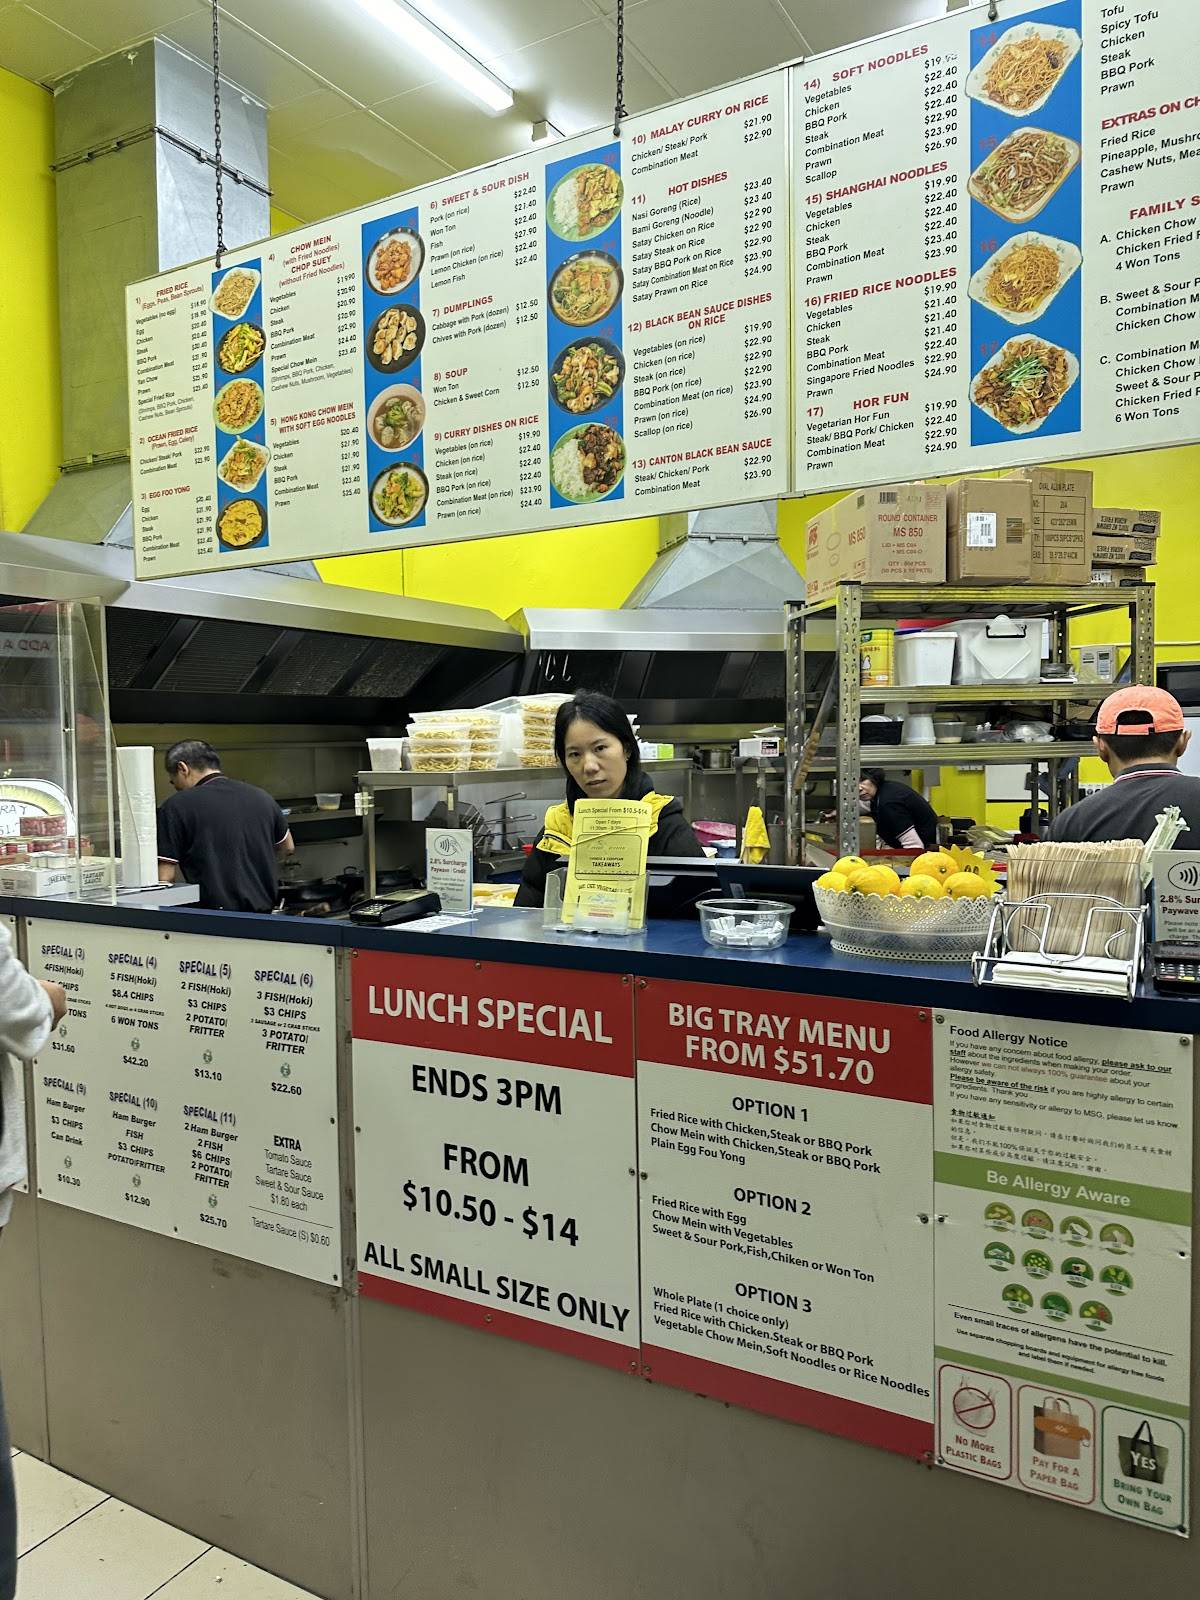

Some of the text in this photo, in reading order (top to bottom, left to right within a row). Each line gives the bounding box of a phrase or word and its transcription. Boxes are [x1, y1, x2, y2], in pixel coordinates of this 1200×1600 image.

[1100, 5, 1124, 17] Tofu
[1100, 10, 1158, 33] Spicy Tofu
[1100, 30, 1144, 48] Chicken
[1100, 48, 1131, 64] Steak
[803, 44, 928, 90] 14) SOFT NOODLES
[924, 65, 957, 83] $22.40
[1100, 57, 1154, 79] BBQ Pork
[1100, 80, 1134, 94] Prawn
[631, 94, 768, 144] 10) MALAY CURRY ON RICE
[743, 113, 771, 128] $21.90
[1101, 100, 1180, 130] EXTRAS ON
[1100, 128, 1155, 147] Fried Rice
[631, 171, 727, 204] 11) HOT DISHES
[744, 176, 771, 191] $23.40
[805, 161, 947, 204] 15) SHANGHAI NOODLES
[1129, 198, 1185, 219] FAMILY
[290, 234, 331, 253] CHOW MEIN
[291, 254, 331, 273] CHOP SUEY
[156, 281, 188, 297] FRIED RICE
[804, 267, 956, 306] 16) FRIED RICE NOODLES
[627, 292, 771, 332] 12) BLACK BEAN SAUCE DISHES
[688, 313, 725, 329] ON RICE
[806, 359, 914, 385] Singapore Fried Noodles
[433, 397, 457, 406] Chicken
[464, 390, 483, 400] Sweet
[484, 388, 499, 396] Corn
[806, 391, 909, 417] 17) HOR FUN
[924, 399, 957, 412] $19.90
[434, 414, 538, 440] 9) CURRY DISHES ON RICE
[632, 438, 771, 469] 13) CANTON BLACK BEAN SAUCE
[903, 513, 937, 521] CONTAINER
[893, 526, 923, 537] MS 850
[623, 807, 648, 815] $10.5-$14
[1159, 894, 1182, 903] 2.8%
[1162, 906, 1198, 915] Paywave
[41, 944, 84, 960] SPECIAL (3)
[107, 953, 157, 968] SPECIAL (4)
[179, 960, 231, 978] SPECIAL (5)
[254, 970, 313, 987] SPECIAL (6)
[256, 990, 312, 1007] 3 FISH(Hoki)
[264, 1006, 306, 1019] $3 CHIPS
[369, 985, 612, 1043] LUNCH SPECIAL
[111, 1015, 158, 1030] 6 WON TONS
[669, 1002, 890, 1053] BIG TRAY MENU
[950, 1025, 1067, 1047] Food Allergy Notice
[52, 1041, 74, 1053] $31.60
[123, 1055, 148, 1067] $42.20
[686, 1034, 874, 1084] FROM $51.70
[194, 1068, 222, 1080] $13.10
[271, 1081, 301, 1095] $22.60
[412, 1064, 561, 1114] ENDS 3PM
[109, 1091, 157, 1110] SPECIAL (10)
[732, 1096, 807, 1121] OPTION 1
[183, 1104, 236, 1126] SPECIAL (11)
[650, 1107, 872, 1156] Fried Rice with Chicken,Steak or BBQ Pork
[273, 1135, 301, 1151] EXTRA
[443, 1142, 528, 1186] FROM
[986, 1169, 1130, 1206] Be Allergy Aware
[124, 1192, 150, 1206] $12.90
[733, 1187, 811, 1215] OPTION 2
[199, 1213, 227, 1228] $25.70
[403, 1179, 496, 1226] $10.50
[522, 1205, 578, 1246] $14
[364, 1241, 630, 1331] ALL SMALL SIZE ONLY
[735, 1282, 811, 1312] OPTION 3
[954, 1311, 973, 1321] Even
[974, 1317, 994, 1326] small
[995, 1321, 1019, 1332] traces
[1030, 1330, 1066, 1343] allergens
[1068, 1337, 1087, 1348] have
[1089, 1343, 1102, 1351] the
[1104, 1347, 1140, 1360] potential
[1152, 1357, 1167, 1366] kill.
